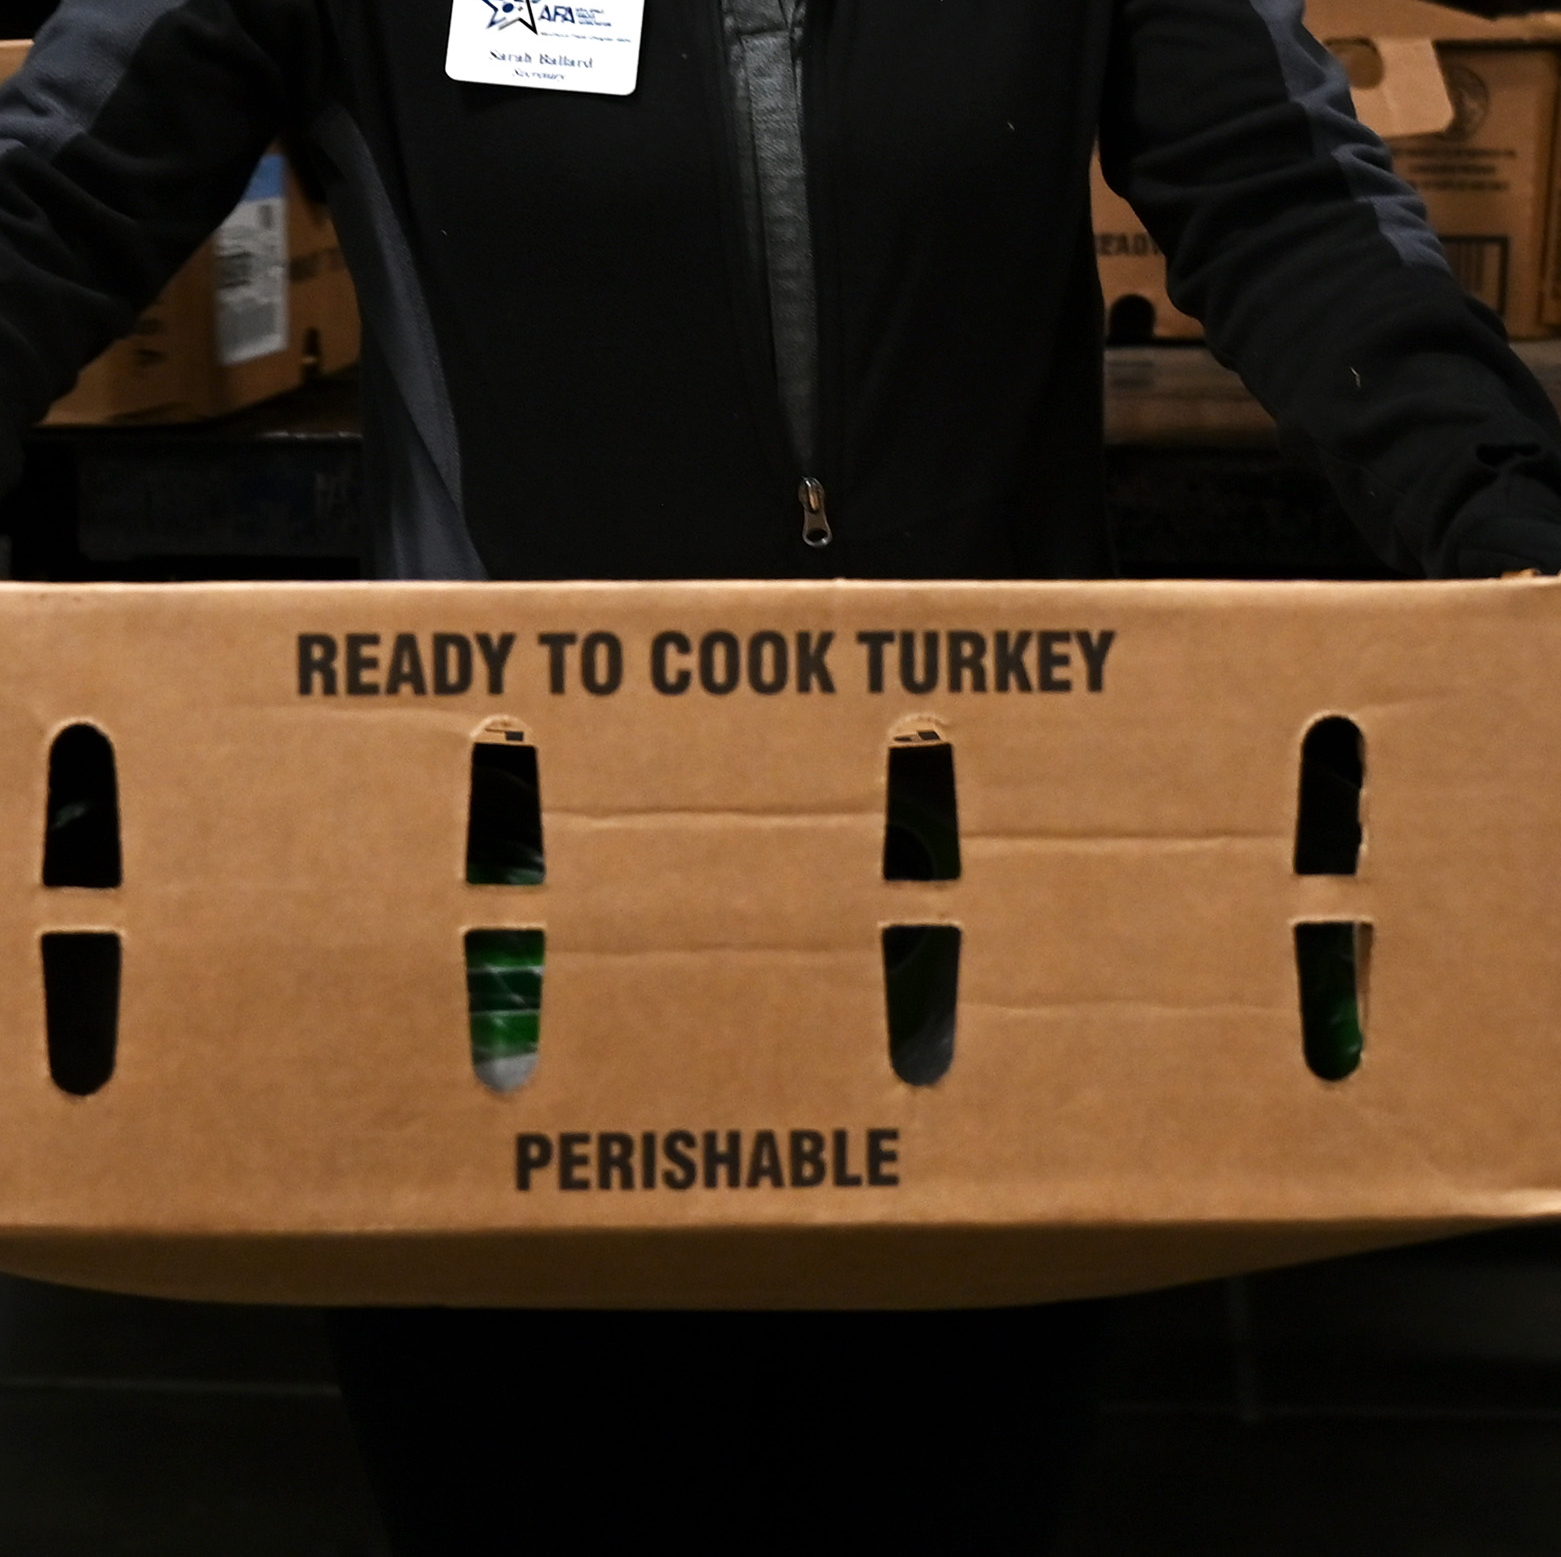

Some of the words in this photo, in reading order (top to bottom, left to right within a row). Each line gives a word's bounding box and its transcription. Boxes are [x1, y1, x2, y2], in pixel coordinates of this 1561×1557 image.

[296, 631, 518, 697] READY
[537, 631, 624, 696] TO
[650, 630, 838, 696] COOK
[856, 629, 1117, 694] TURKEY
[515, 1128, 901, 1191] PERISHABLE
